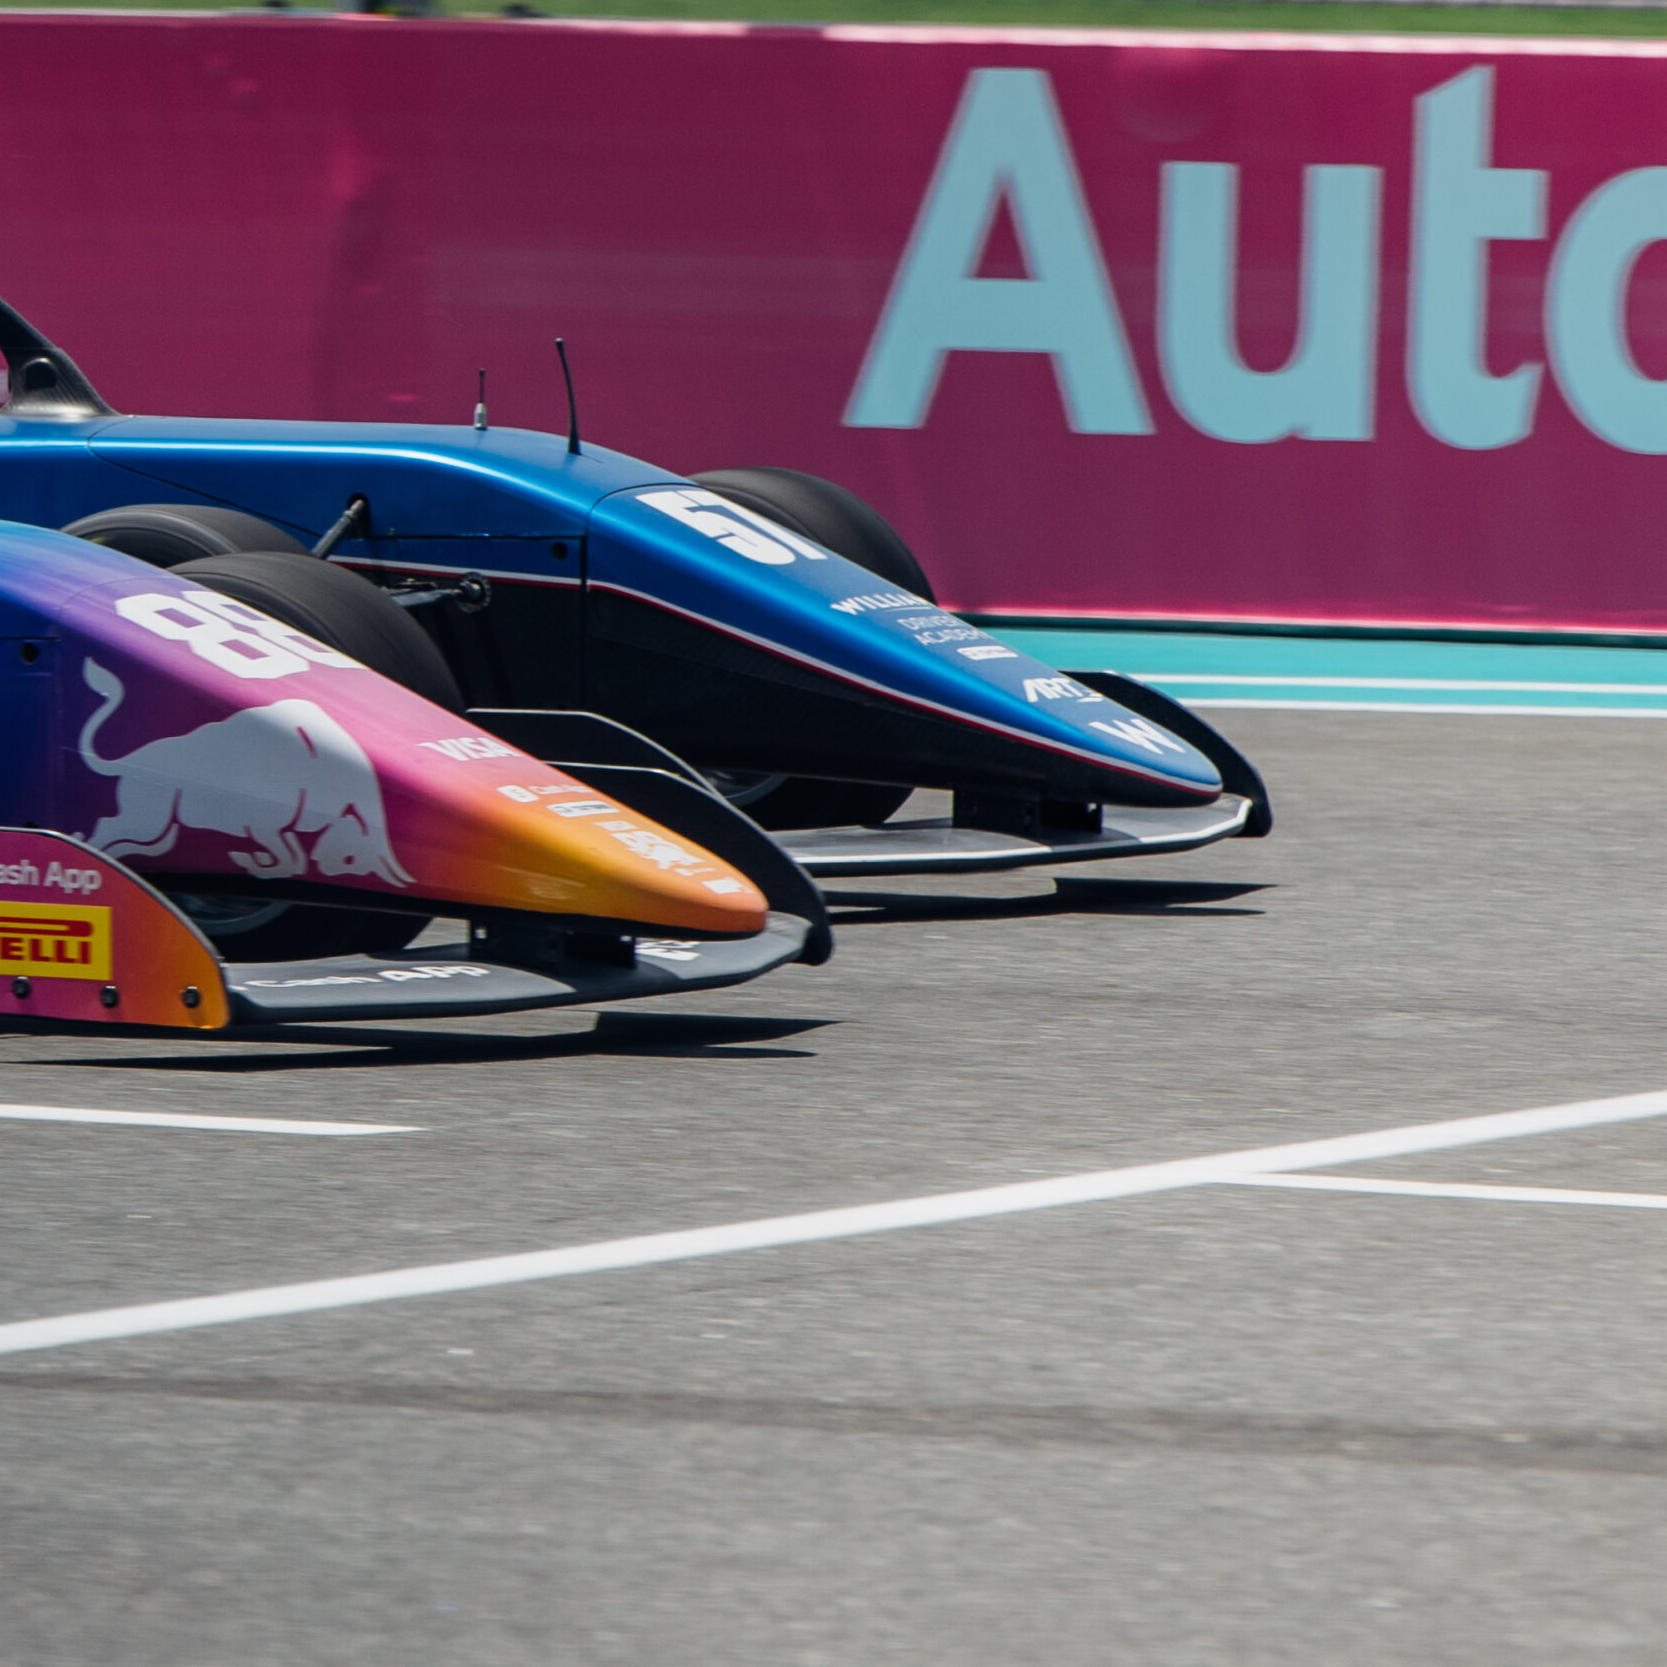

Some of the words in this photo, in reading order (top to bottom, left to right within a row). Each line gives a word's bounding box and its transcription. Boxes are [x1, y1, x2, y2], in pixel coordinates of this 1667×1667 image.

[830, 592, 931, 616] WILLIA
[114, 589, 369, 680] 88
[415, 736, 524, 762] VISA
[43, 860, 102, 895] App
[378, 964, 490, 984] App
